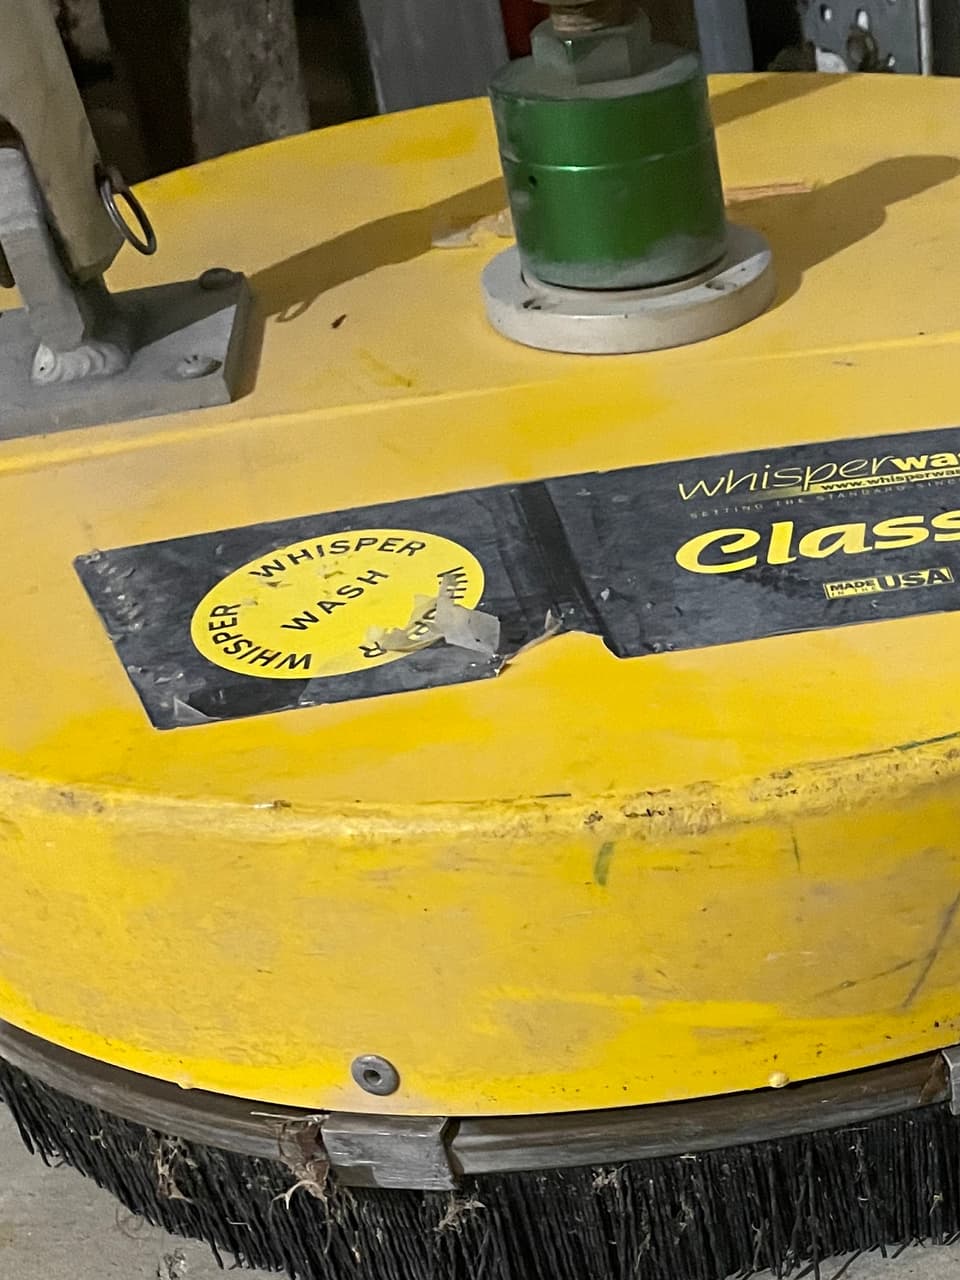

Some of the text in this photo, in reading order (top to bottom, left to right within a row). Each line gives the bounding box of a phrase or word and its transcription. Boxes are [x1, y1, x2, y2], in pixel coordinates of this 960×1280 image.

[249, 537, 426, 579] WHISPER
[829, 568, 950, 592] MADE USA
[280, 569, 389, 632] WASH
[208, 603, 312, 670] WHISPER
